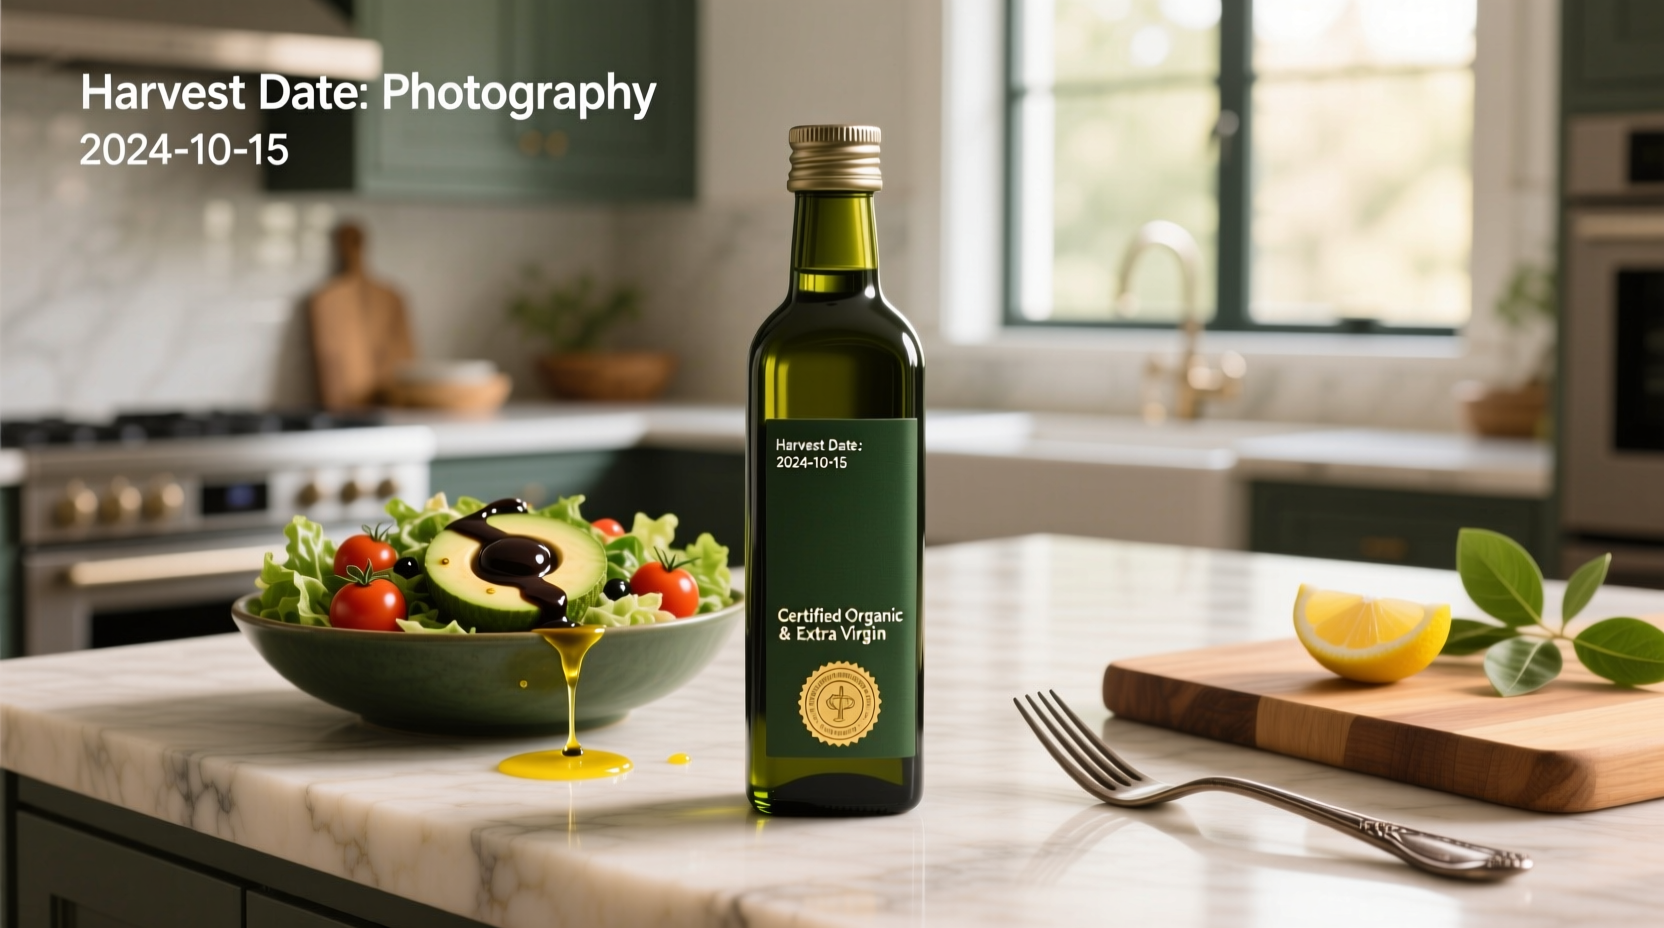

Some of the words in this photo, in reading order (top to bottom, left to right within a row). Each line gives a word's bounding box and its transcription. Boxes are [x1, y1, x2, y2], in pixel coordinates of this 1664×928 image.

[776, 438, 825, 451] Harvest
[828, 438, 863, 452] Date:
[776, 456, 848, 469] 2024-10-15
[777, 607, 842, 623] Certified
[845, 607, 904, 626] Organic
[778, 626, 791, 641] &
[796, 626, 837, 641] Extra
[840, 625, 887, 645] Virgin
